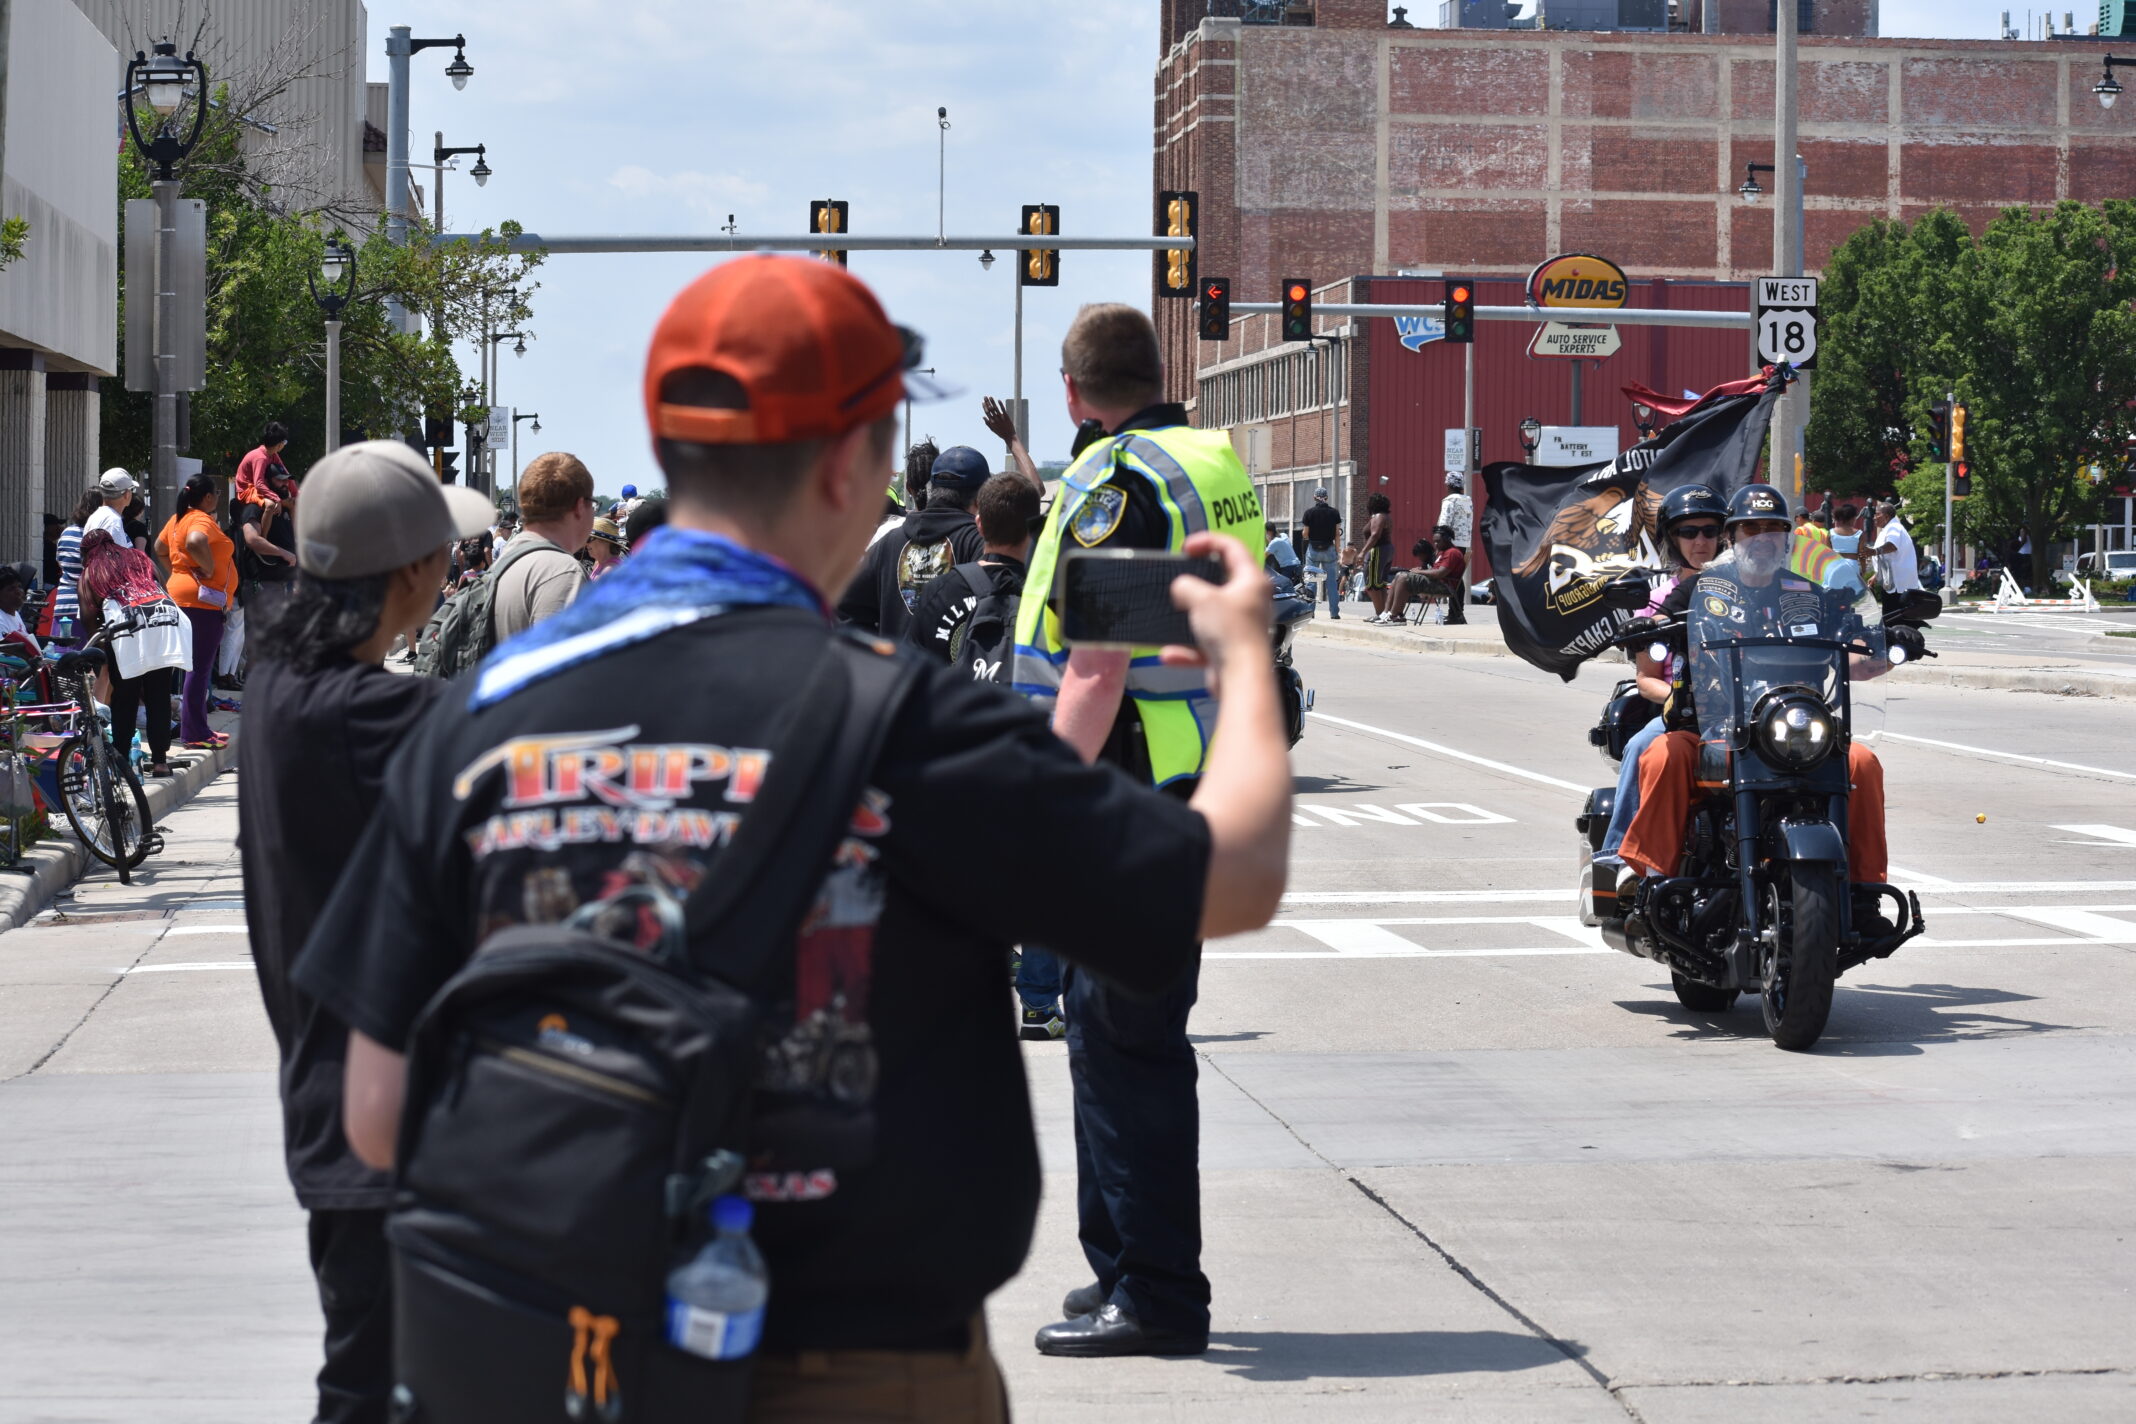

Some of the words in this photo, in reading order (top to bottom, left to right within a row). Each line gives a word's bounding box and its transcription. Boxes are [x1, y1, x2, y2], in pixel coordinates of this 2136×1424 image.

[1542, 278, 1625, 300] MIDAS
[1765, 281, 1811, 302] WEST
[1547, 334, 1570, 344] AUTO
[1572, 334, 1607, 344] SERVICE
[1769, 321, 1805, 353] 18
[1559, 344, 1596, 353] EXPERTS
[1212, 490, 1260, 528] POLICE
[1752, 499, 1774, 508] HOG
